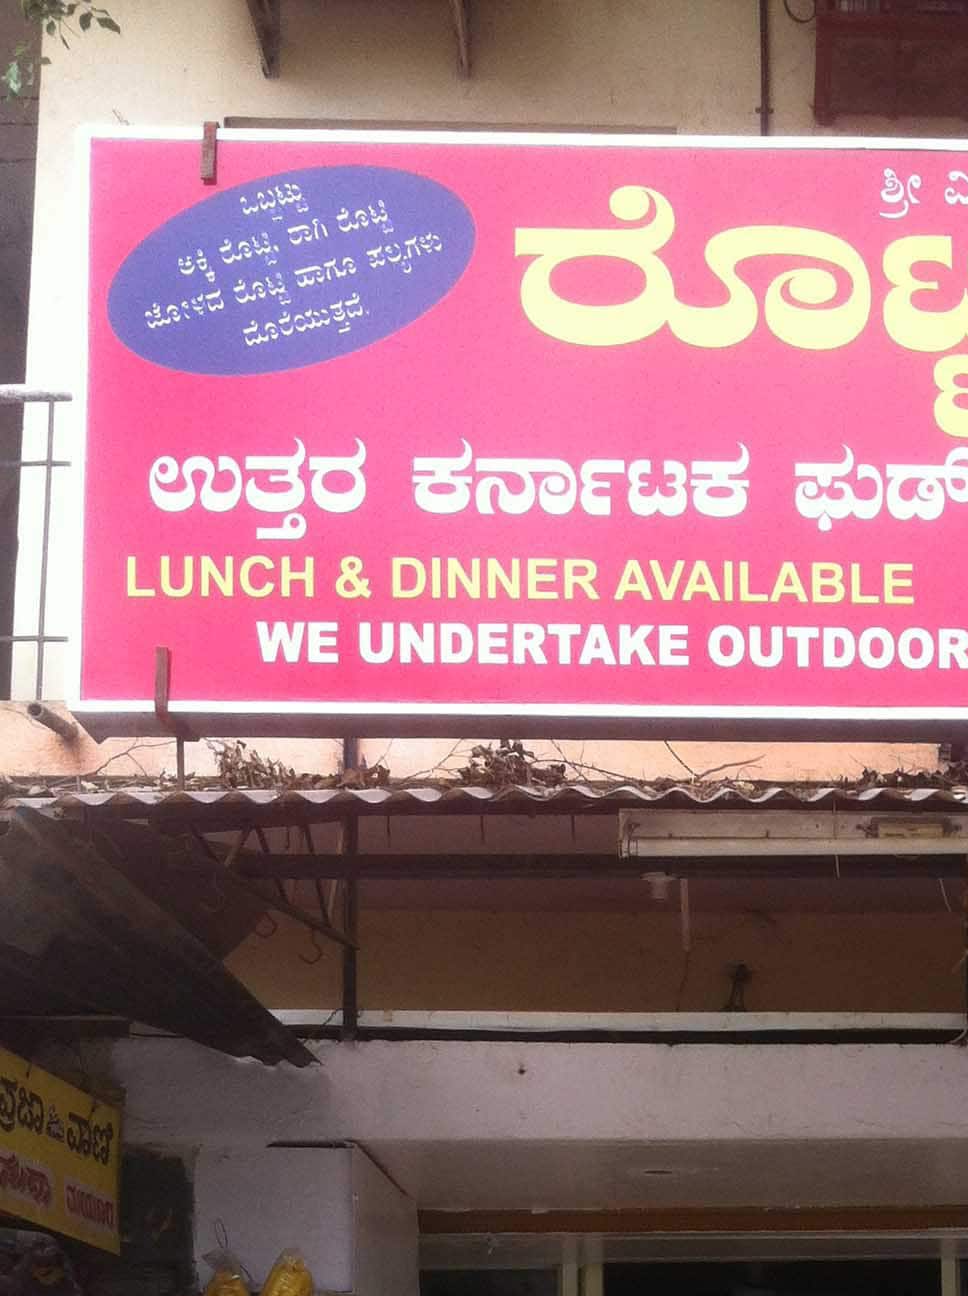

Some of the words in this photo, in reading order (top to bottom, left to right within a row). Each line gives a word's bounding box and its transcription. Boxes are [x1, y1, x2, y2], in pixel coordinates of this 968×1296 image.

[879, 167, 922, 218] ಶ್ರೀ
[287, 217, 329, 245] ರಾಗಿ
[294, 256, 358, 288] ಹಾಗೂ
[147, 437, 367, 541] ಉತ್ತರ
[411, 437, 751, 518] ಕರ್ನಾಟಕ
[126, 555, 315, 599] LUNCH
[334, 556, 371, 600] &
[391, 556, 600, 601] DINNER
[614, 559, 915, 605] AVAILABLE
[256, 620, 339, 664] WE
[358, 621, 690, 667] UNDERTAKE
